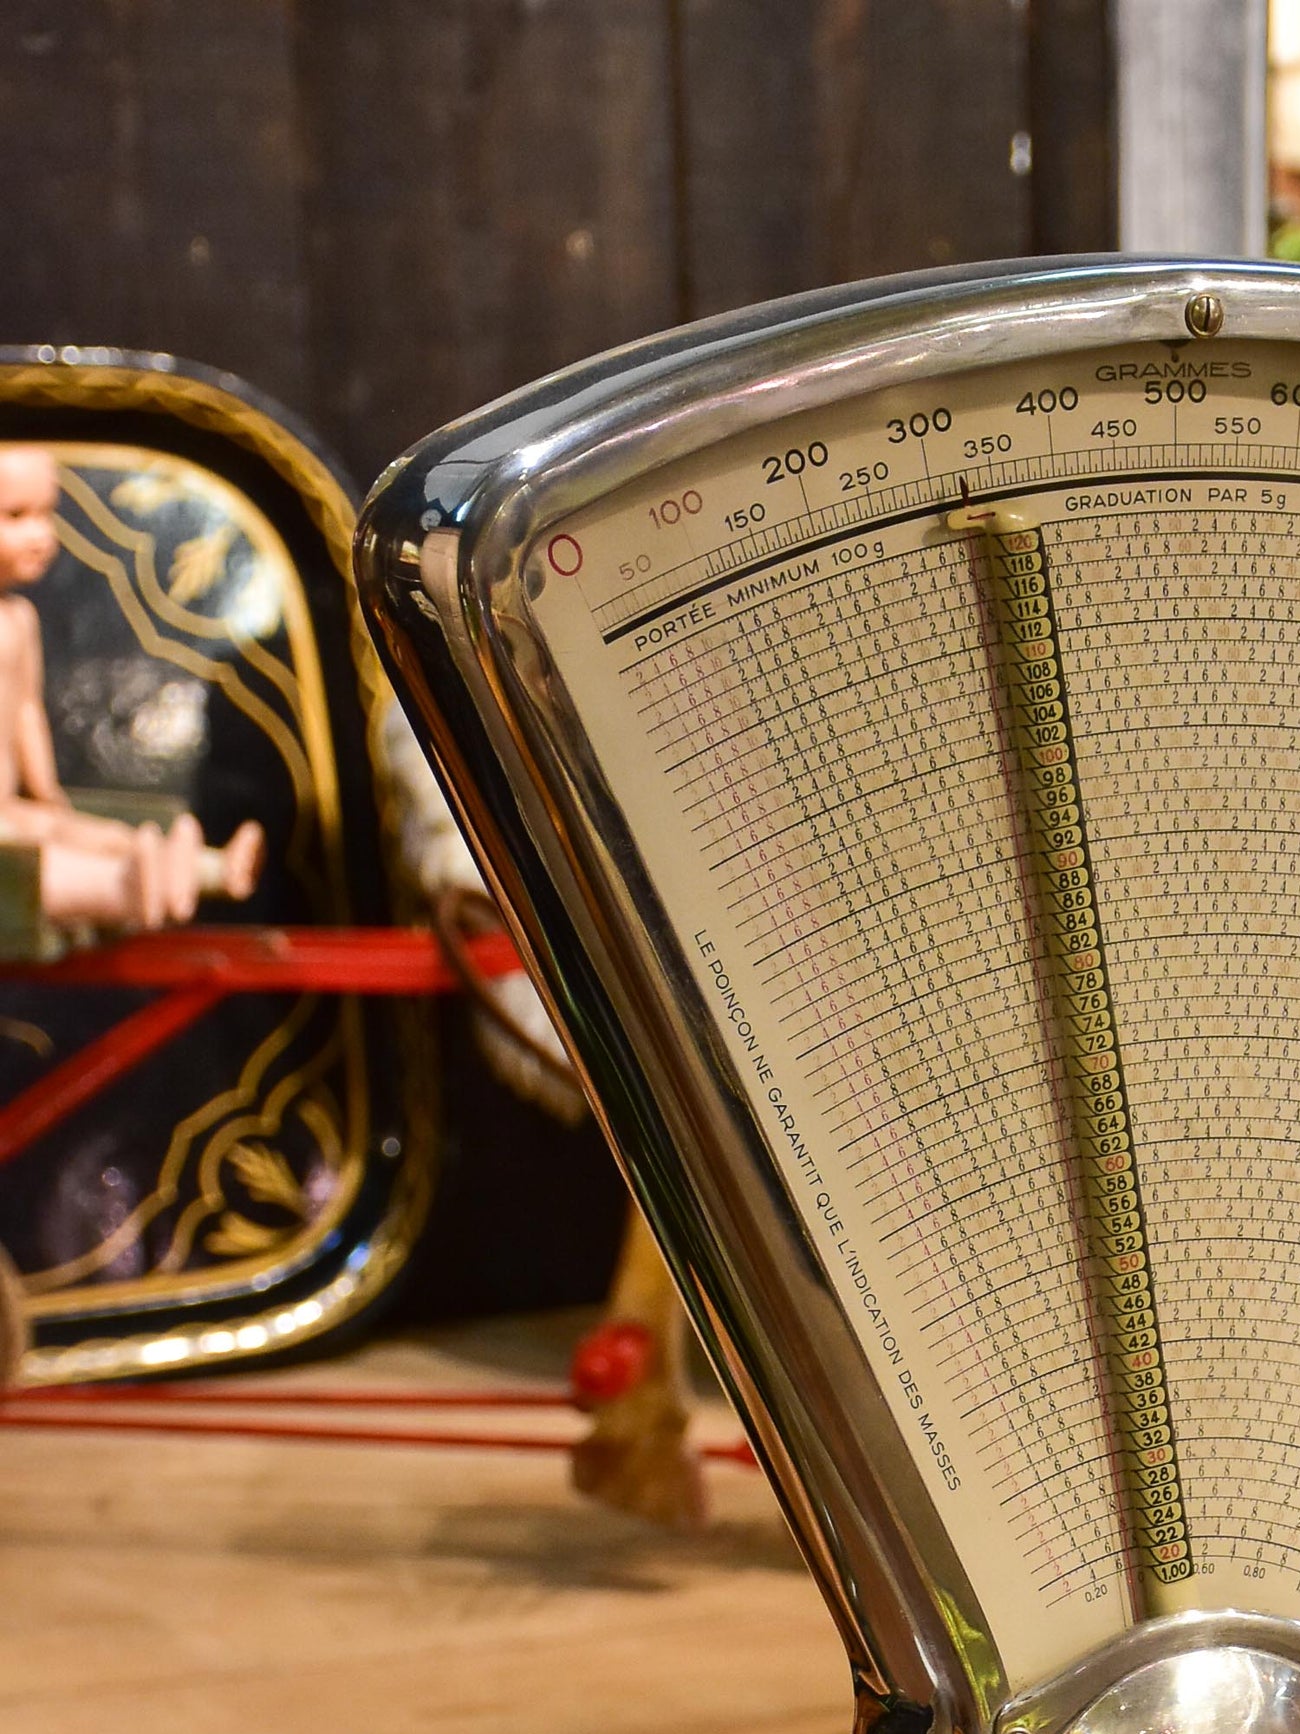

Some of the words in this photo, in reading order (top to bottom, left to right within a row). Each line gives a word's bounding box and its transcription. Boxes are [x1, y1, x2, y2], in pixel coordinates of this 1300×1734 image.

[1095, 361, 1252, 381] GRAMMES
[548, 533, 583, 576] 0
[648, 490, 703, 530] 100
[762, 441, 828, 483] 200
[886, 408, 952, 443] 300
[1016, 387, 1079, 416] 400
[1144, 379, 1206, 404] 500
[619, 554, 650, 581] 50
[724, 503, 766, 532] 150
[839, 461, 889, 491] 250
[964, 434, 1012, 458] 350
[1091, 419, 1137, 437] 450
[1215, 417, 1261, 435] 550
[1065, 488, 1191, 511] GRADUATION
[1208, 488, 1247, 502] PAR
[1008, 535, 1031, 550] 120
[1010, 555, 1035, 572] 118
[1014, 577, 1038, 595] 116
[634, 602, 717, 651] PORTÉE
[726, 559, 820, 607] MINIMUM
[1018, 599, 1040, 617] 114
[1020, 622, 1042, 639] 112
[1025, 642, 1046, 658] 110
[1027, 662, 1051, 679] 108
[1030, 683, 1053, 700] 106
[1033, 704, 1056, 722] 104
[1036, 727, 1059, 743] 102
[1039, 748, 1063, 764] 100
[1043, 767, 1065, 786] 98
[1047, 788, 1068, 805] 96
[1050, 809, 1070, 826] 94
[1053, 830, 1074, 847] 92
[1057, 852, 1077, 868] 90
[1059, 871, 1080, 888] 88
[1063, 891, 1084, 908] 86
[1066, 912, 1087, 929] 84
[1069, 932, 1091, 950] 82
[1074, 954, 1094, 971] 80
[1075, 972, 1097, 991] 78
[1080, 994, 1100, 1011] 76
[1083, 1014, 1104, 1032] 74
[1086, 1035, 1107, 1051] 72
[1091, 1055, 1109, 1070] 70
[1091, 1074, 1112, 1093] 68
[1094, 1096, 1115, 1112] 66
[1097, 1115, 1119, 1133] 64
[1100, 1137, 1122, 1154] 62
[1105, 1155, 1125, 1171] 60
[1107, 1175, 1127, 1193] 58
[694, 929, 715, 957] LE
[708, 959, 759, 1052] POINÇON
[752, 1055, 773, 1084] NE
[768, 1088, 823, 1185] GARANTIT
[816, 1192, 844, 1236] QUE
[838, 1239, 903, 1364] L'INDICATION
[899, 1370, 923, 1409] DES
[918, 1413, 960, 1491] MASSES
[1109, 1194, 1130, 1213] 56
[1112, 1215, 1133, 1233] 54
[1115, 1236, 1136, 1253] 52
[1119, 1254, 1139, 1270] 50
[1121, 1275, 1141, 1290] 48
[1124, 1294, 1144, 1310] 46
[1126, 1313, 1146, 1330] 44
[1129, 1333, 1149, 1349] 42
[1132, 1352, 1152, 1368] 40
[1135, 1371, 1154, 1388] 38
[1137, 1392, 1158, 1407] 36
[1140, 1410, 1160, 1426] 34
[1142, 1430, 1163, 1446] 32
[1147, 1449, 1166, 1465] 30
[1150, 1467, 1169, 1484] 28
[1151, 1487, 1172, 1505] 26
[1153, 1507, 1174, 1524] 24
[1155, 1526, 1178, 1544] 22
[1160, 1545, 1180, 1560] 20
[1161, 1562, 1186, 1581] 1.00
[1085, 1584, 1108, 1603] 0.20
[1243, 1564, 1266, 1579] 0.80
